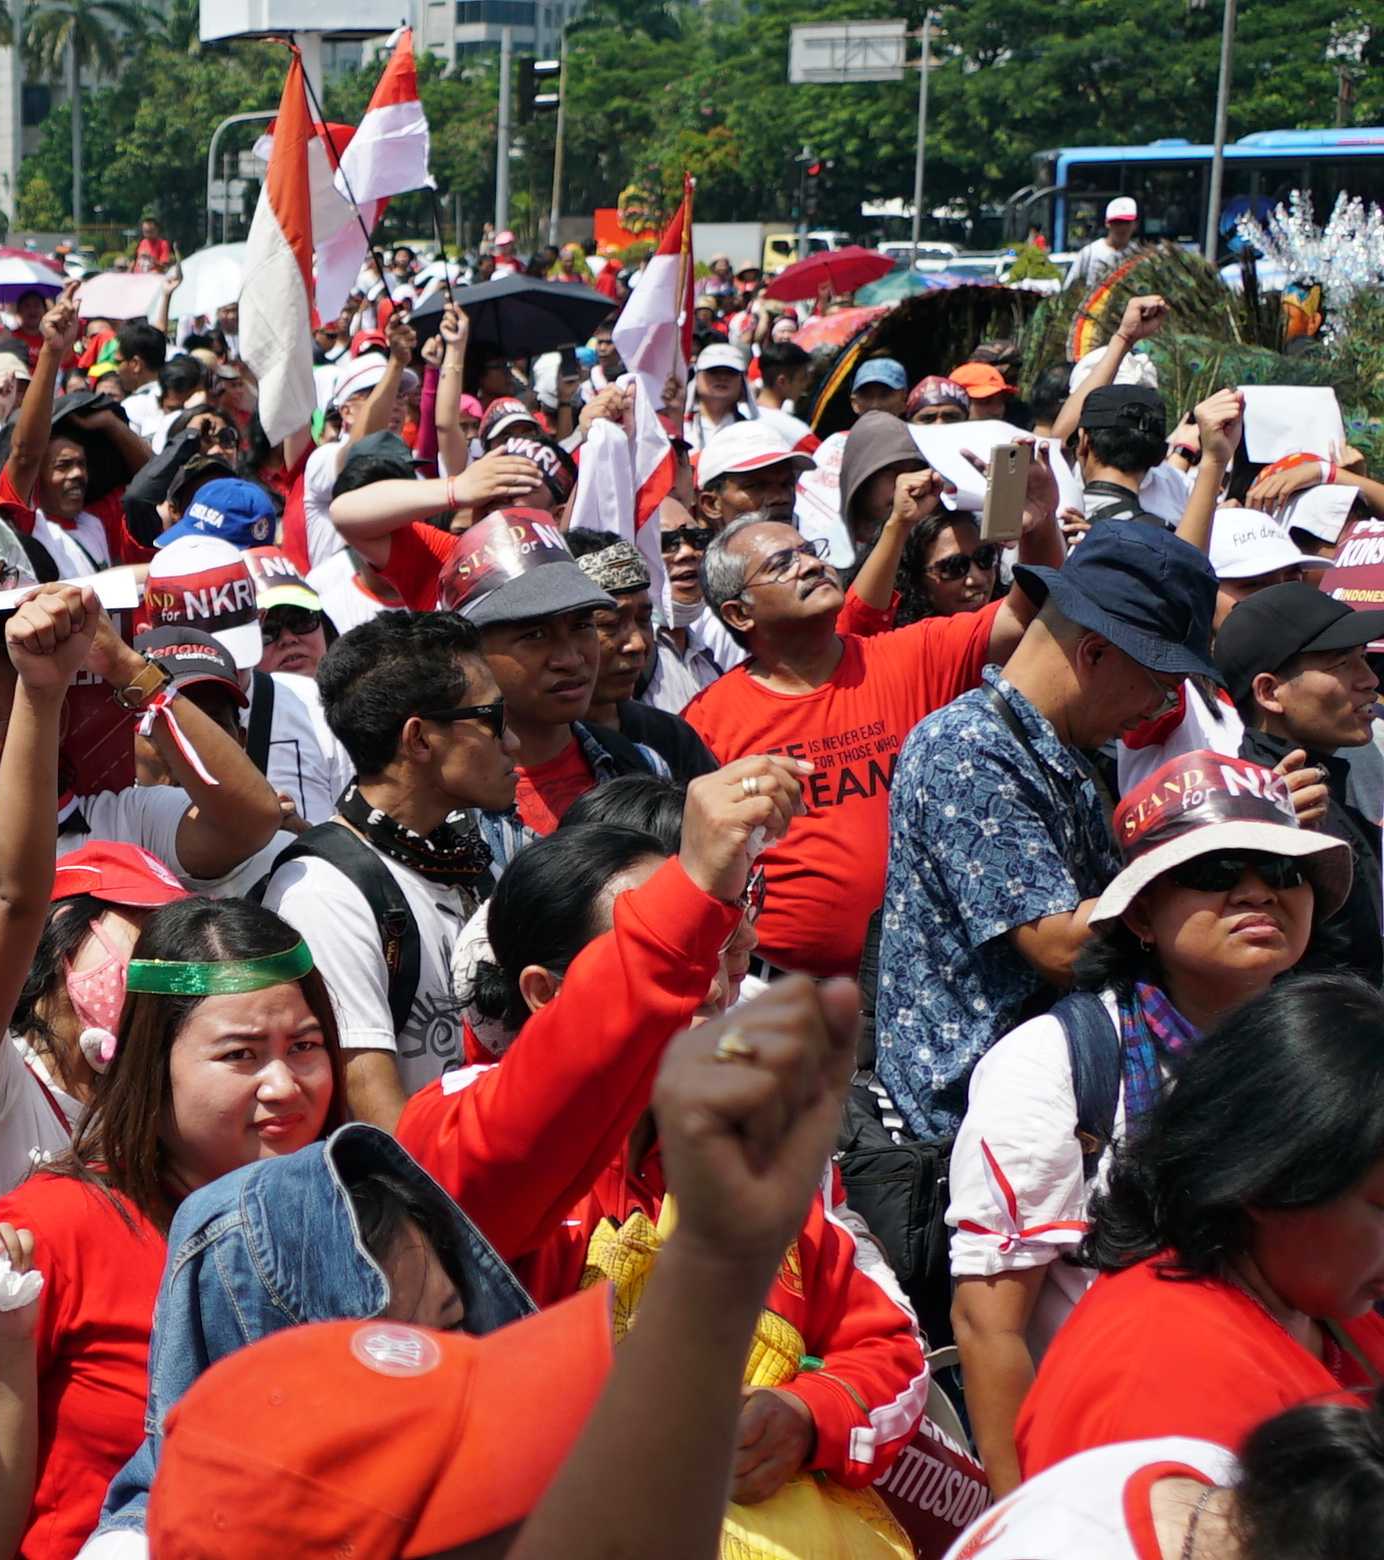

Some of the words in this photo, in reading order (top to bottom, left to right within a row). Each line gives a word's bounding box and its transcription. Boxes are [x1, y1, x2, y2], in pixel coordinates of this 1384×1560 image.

[505, 437, 562, 477] NKRI
[458, 525, 527, 580] STAD
[161, 608, 181, 622] for
[807, 739, 820, 753] IS
[822, 729, 860, 751] NEVER
[860, 720, 887, 738] EASY
[813, 755, 836, 769] FOR
[837, 744, 873, 764] THOSE
[874, 734, 899, 753] WHO
[1124, 769, 1205, 838] STAND
[1181, 787, 1217, 809] for
